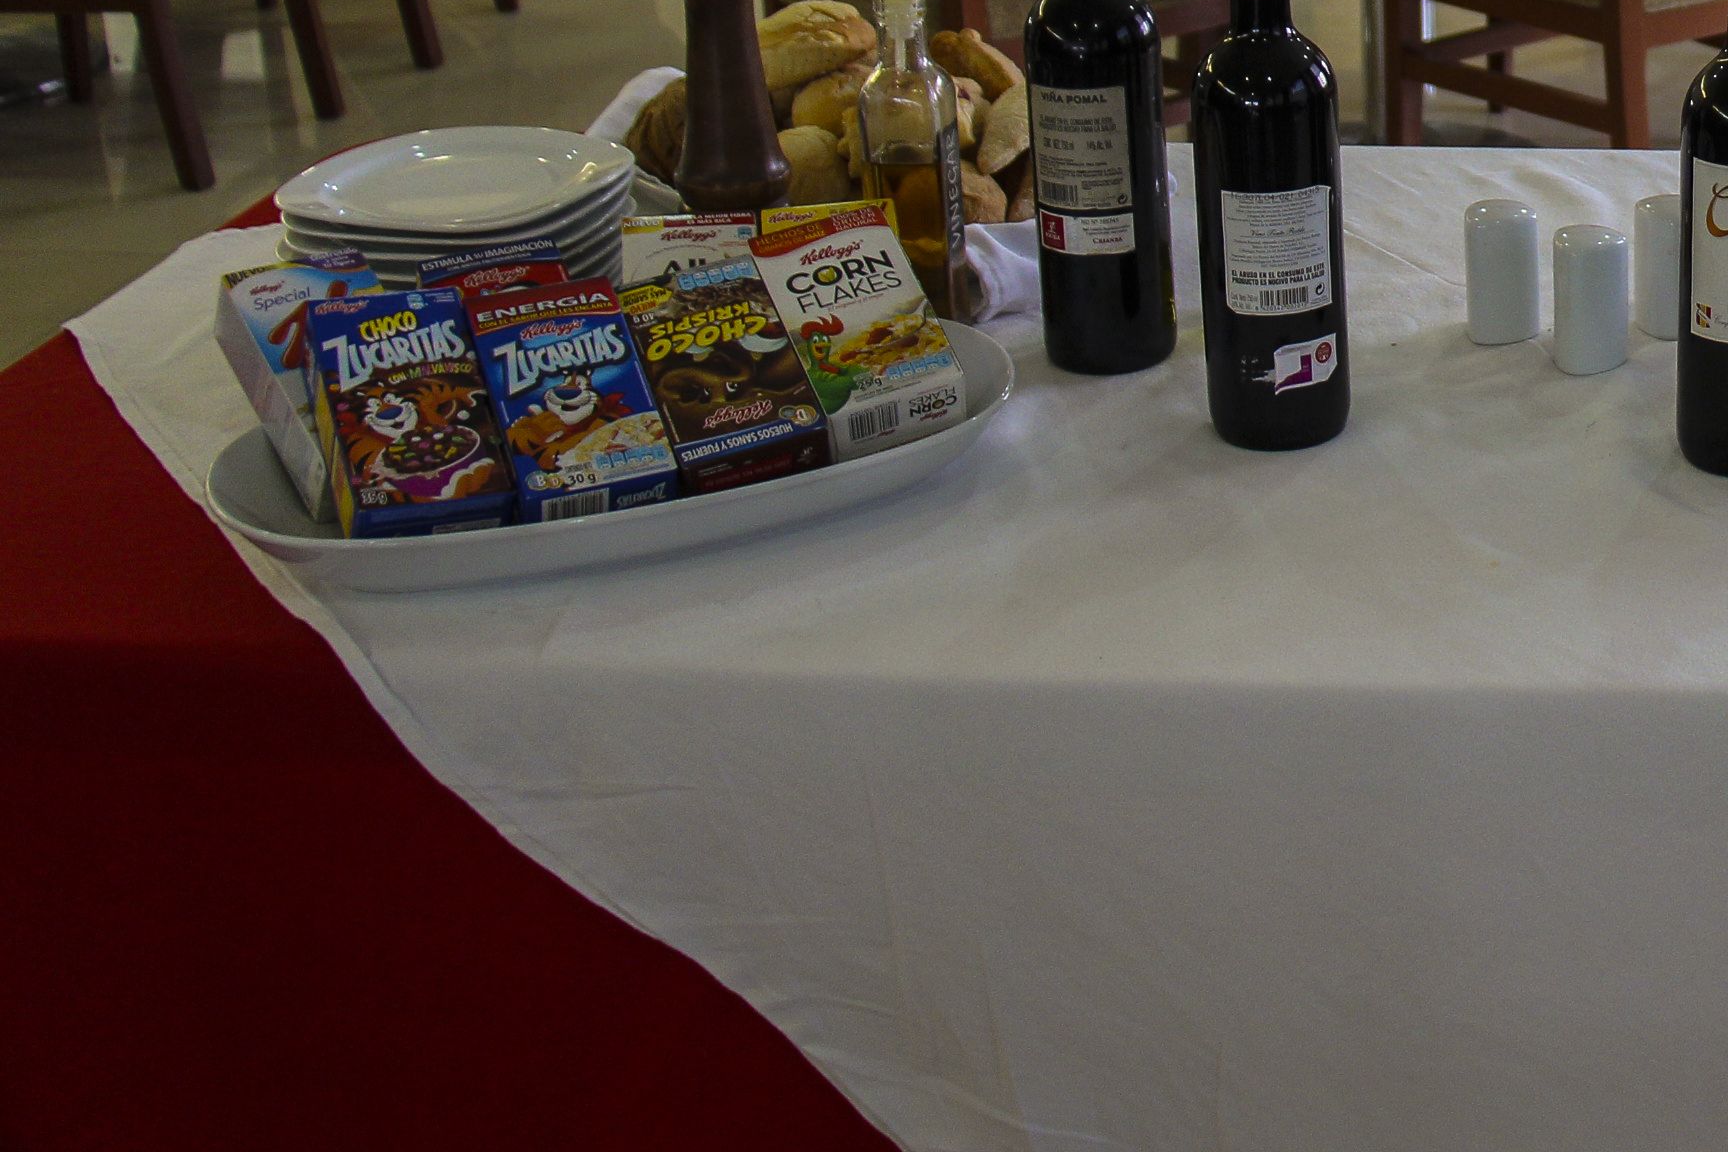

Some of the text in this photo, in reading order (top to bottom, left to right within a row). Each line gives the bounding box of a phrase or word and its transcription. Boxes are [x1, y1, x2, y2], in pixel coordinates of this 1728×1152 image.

[1066, 94, 1108, 105] POMAL
[623, 219, 661, 229] NUEVO
[661, 228, 717, 242] Kellogg's
[421, 254, 473, 272] ESTIMULA
[484, 238, 554, 258] IMAGINACIÓN
[800, 240, 862, 266] Kellogg's
[225, 266, 267, 288] NUEVO
[463, 265, 530, 288] Kellogg's
[786, 249, 895, 295] CORN
[1231, 262, 1325, 279] EL ABUSO EN EL CONSUMO DE ESTE
[1231, 269, 1325, 286] PRODUCTO ES NOCIVO PARA LA SALUD
[254, 287, 311, 312] Special
[796, 270, 902, 314] FLAKES
[360, 310, 418, 344] CHOCO
[479, 320, 498, 330] CON
[498, 318, 508, 326] EL
[510, 312, 539, 324] SABOR
[575, 301, 614, 313] ENCANTA
[648, 300, 751, 340] KRISPIS
[519, 318, 586, 341] Kellogg's
[646, 314, 768, 363] CHOCO
[322, 318, 466, 394] ZUCARITAS
[492, 323, 626, 396] ZUCARITAS
[908, 386, 957, 408] FLAKES
[909, 394, 957, 418] CORN
[702, 399, 774, 429] Kellogg's
[681, 422, 794, 463] HUESOS SANOS Y FUERTES
[567, 473, 597, 487] 30 g
